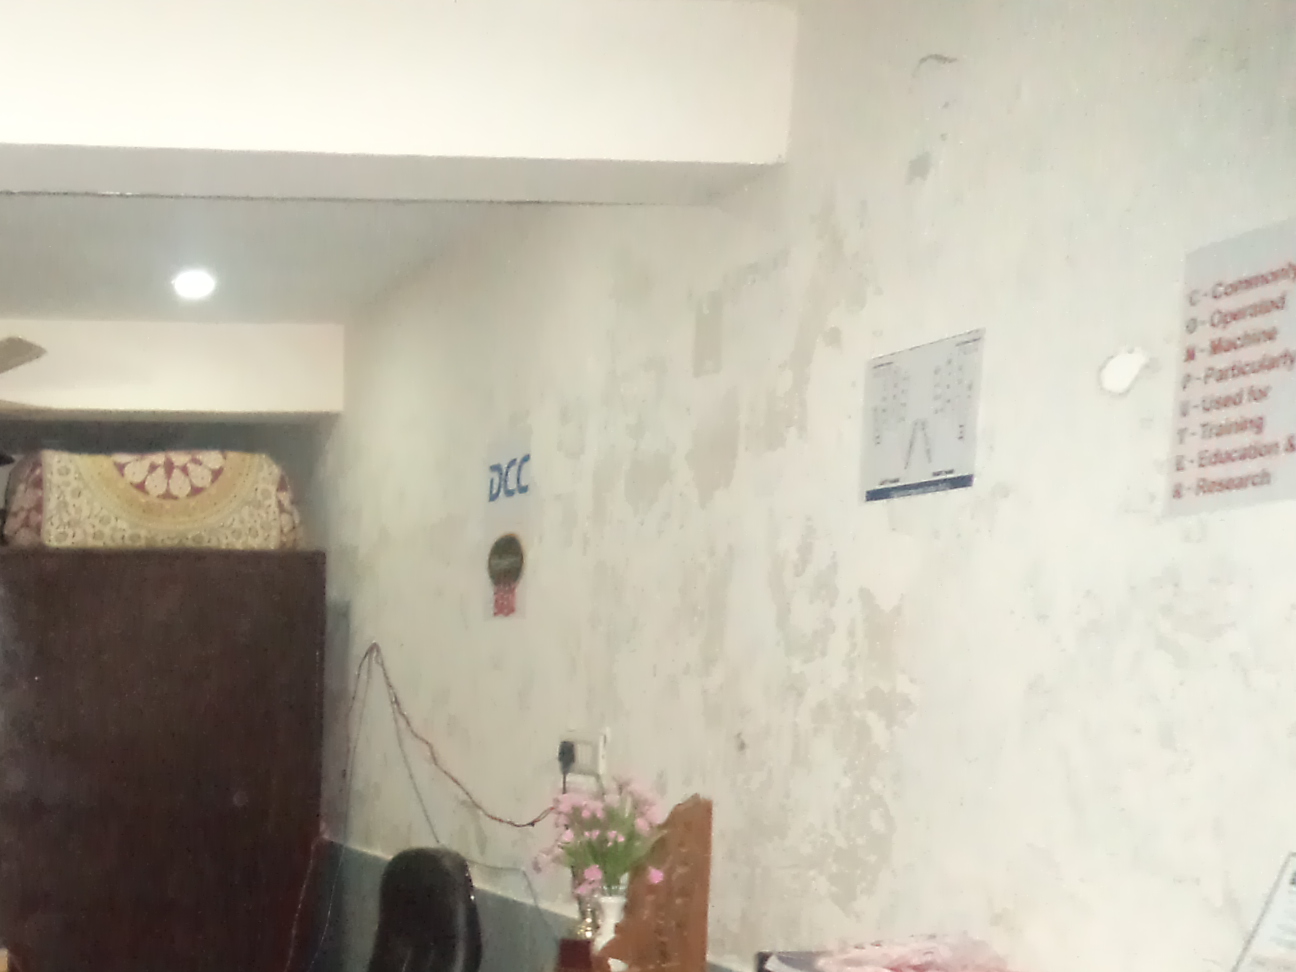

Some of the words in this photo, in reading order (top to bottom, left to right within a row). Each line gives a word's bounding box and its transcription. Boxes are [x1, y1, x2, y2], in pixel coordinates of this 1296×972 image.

[1202, 388, 1245, 412] Used
[1197, 441, 1280, 468] Education
[488, 454, 531, 502] DCC
[1195, 470, 1272, 496] Research
